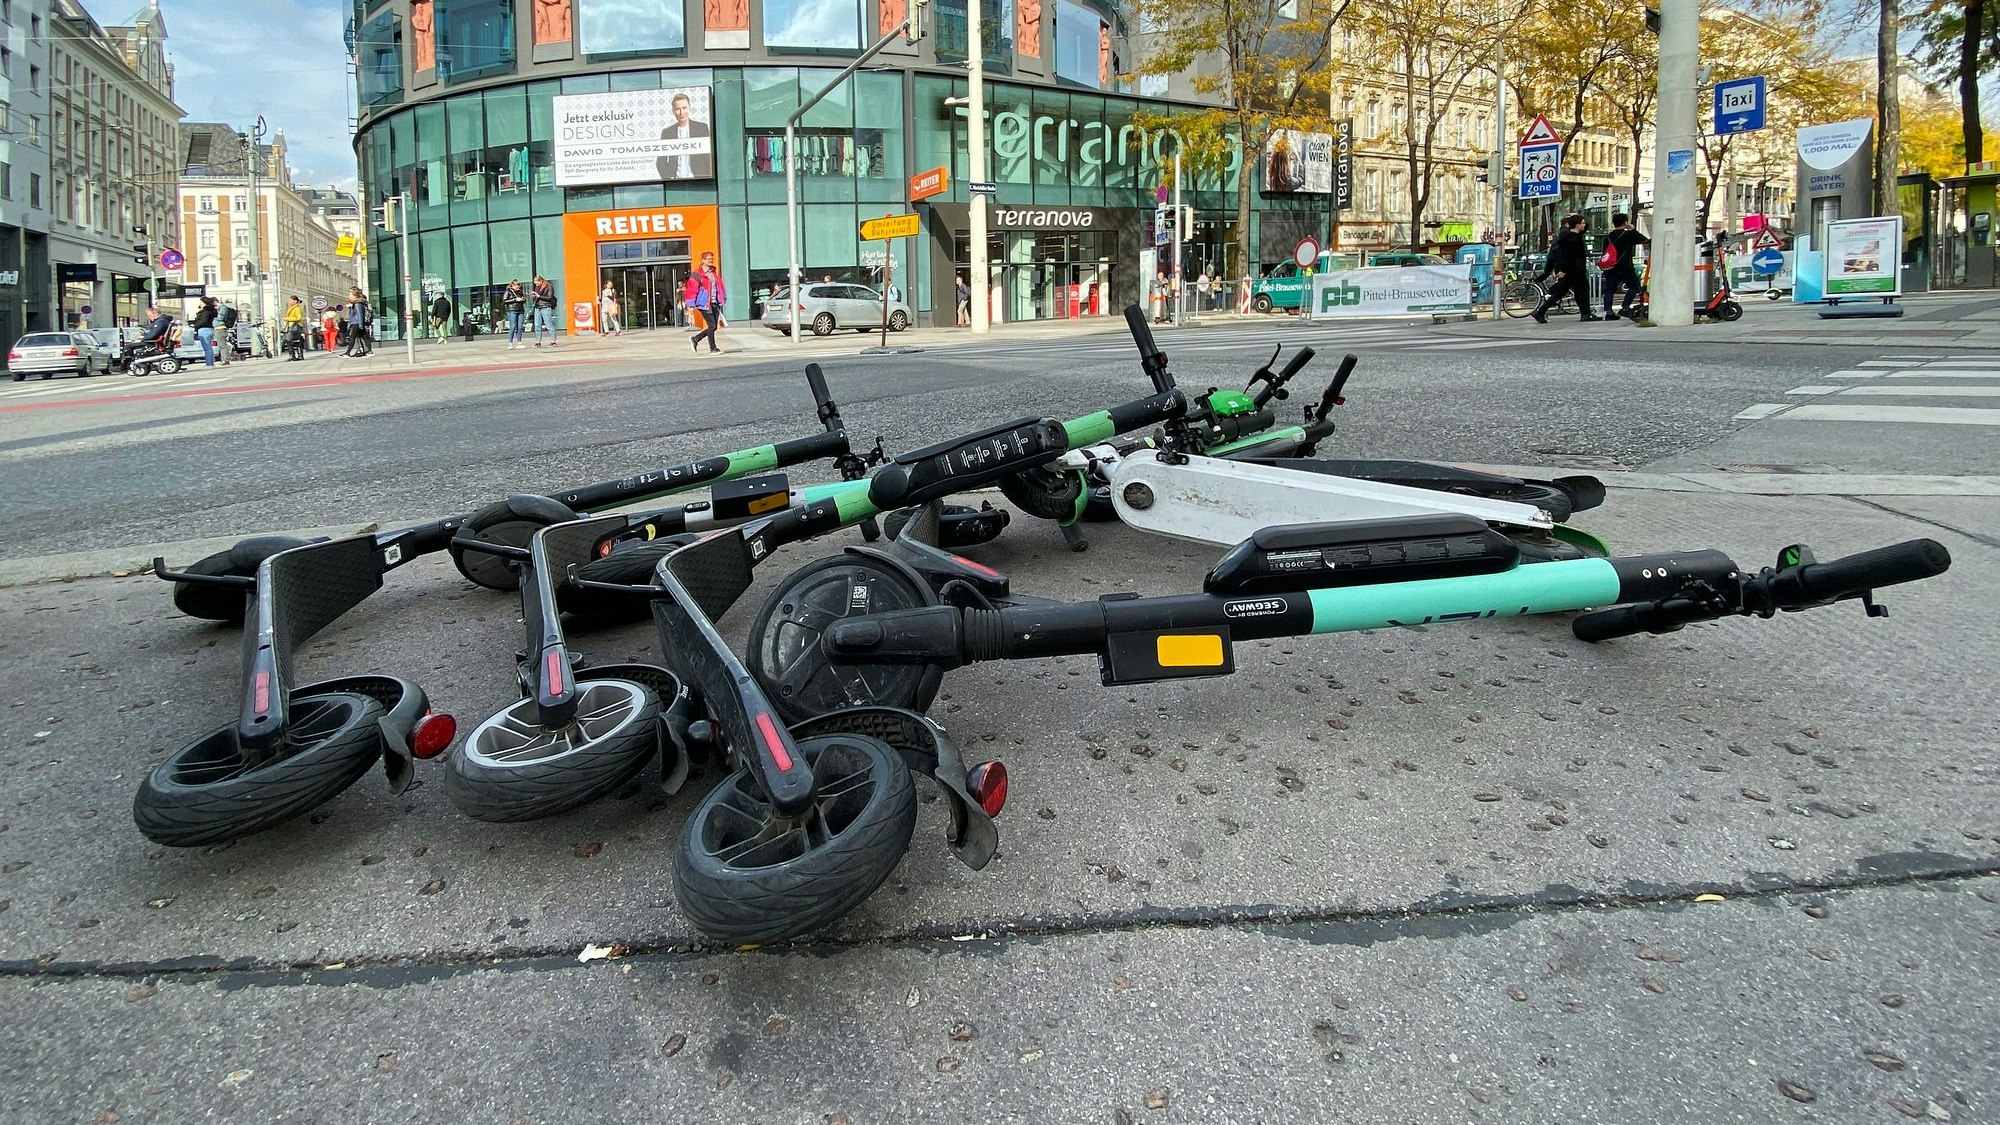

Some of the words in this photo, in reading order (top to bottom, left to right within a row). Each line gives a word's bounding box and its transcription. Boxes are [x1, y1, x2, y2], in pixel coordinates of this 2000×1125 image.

[1724, 90, 1752, 107] Taxi
[563, 112, 589, 124] Jetzt
[592, 109, 634, 121] exklusiv
[563, 124, 635, 141] DESIGNS
[564, 148, 603, 157] DAWID
[610, 142, 701, 155] TOMASZEWSKI
[1309, 139, 1330, 152] ciao!
[1804, 146, 1829, 154] 1.000
[1831, 143, 1857, 151] MAL:
[1309, 151, 1329, 163] WIEN
[920, 174, 940, 188] REITER
[1542, 170, 1554, 180] 20
[1811, 174, 1842, 183] DRINK
[1528, 184, 1552, 193] Zone
[1809, 182, 1845, 191] WATER!
[596, 213, 685, 236] REITER
[871, 219, 912, 228] Umleitung
[1343, 230, 1370, 239] Bandagist
[1363, 289, 1459, 301] Pittel+Brausewetter
[1231, 601, 1279, 611] SEGWAY
